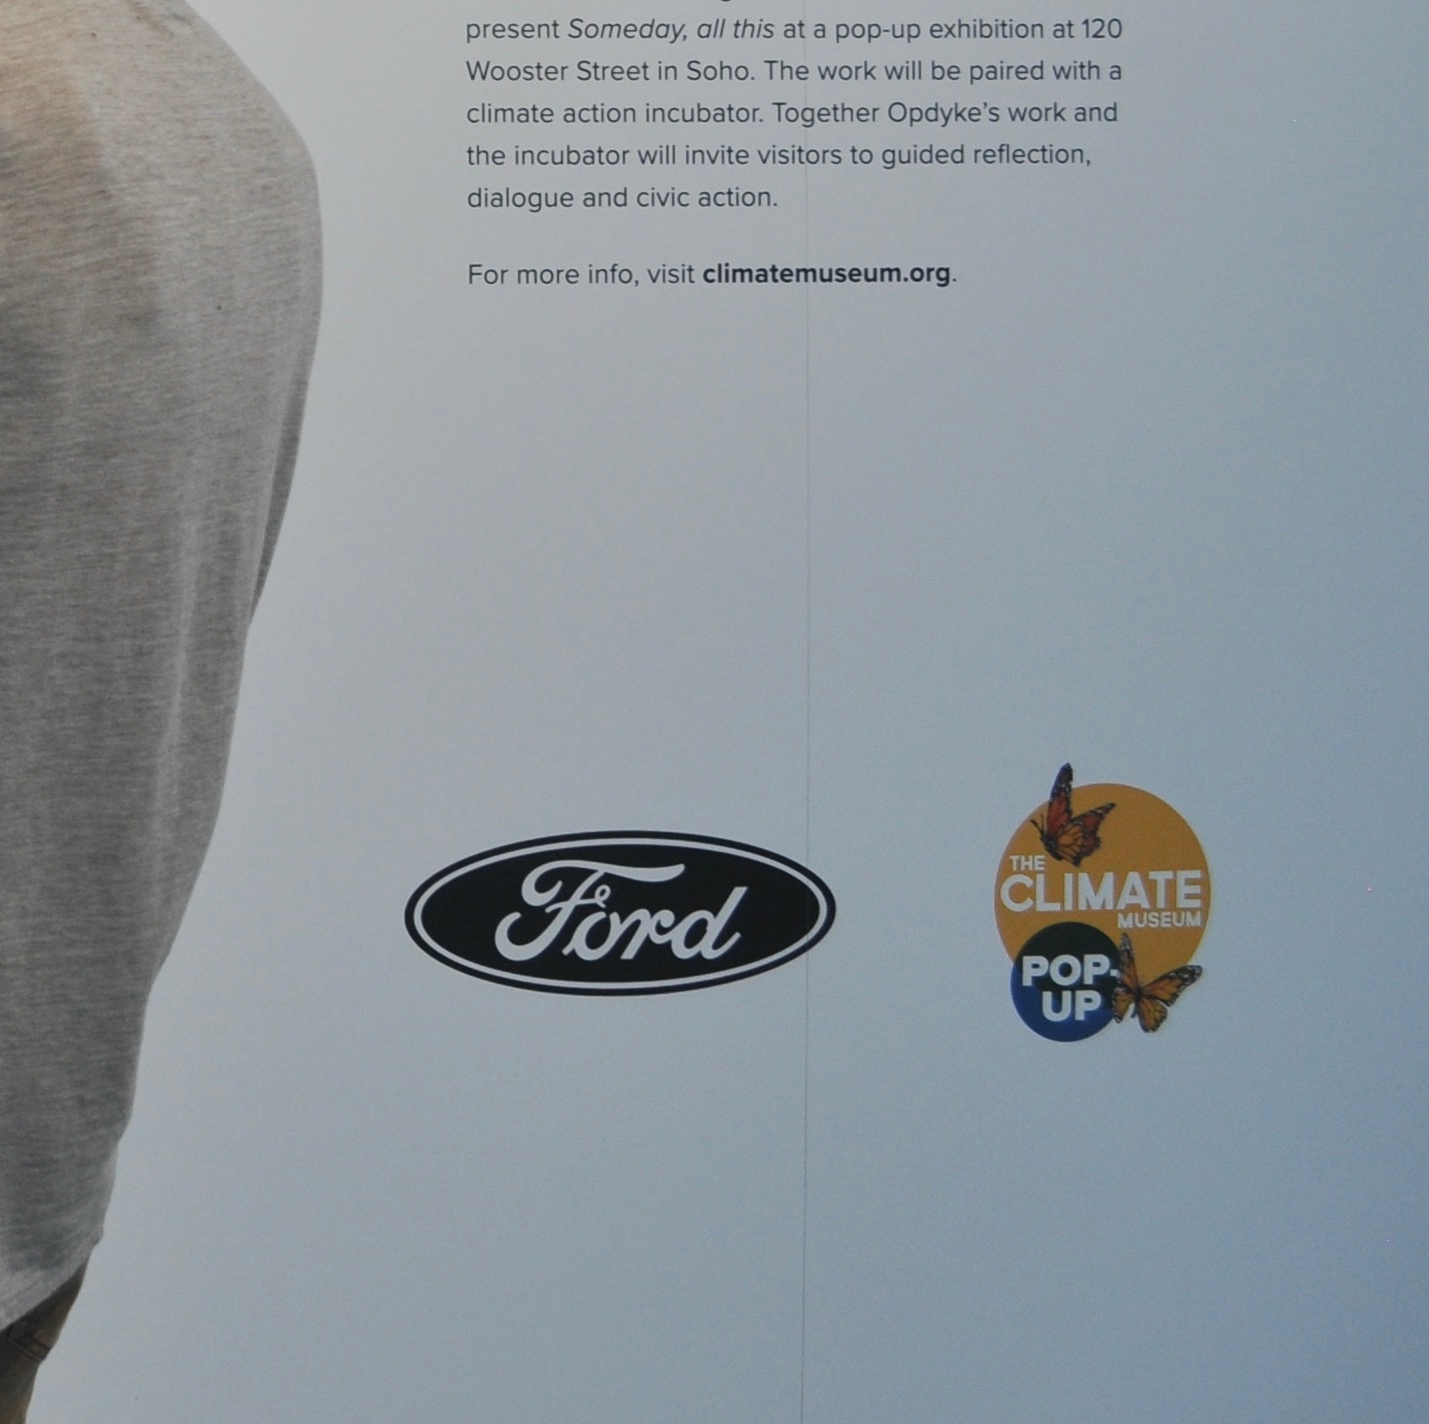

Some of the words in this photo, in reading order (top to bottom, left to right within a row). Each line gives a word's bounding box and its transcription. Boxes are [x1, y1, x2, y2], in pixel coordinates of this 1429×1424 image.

[466, 19, 561, 44] present
[566, 17, 688, 45] Someday,
[696, 17, 727, 39] all
[732, 17, 775, 39] this
[783, 19, 806, 40] at
[813, 22, 827, 40] a
[835, 22, 922, 44] pop-up
[928, 17, 1044, 39] exhibition
[1052, 19, 1076, 39] at
[1081, 17, 1123, 39] 120
[465, 60, 570, 82] Wooster
[576, 59, 651, 82] Street
[657, 60, 678, 81] in
[686, 59, 756, 82] Soho.
[762, 59, 810, 81] The
[816, 59, 878, 81] work
[883, 59, 923, 81] will
[930, 59, 962, 81] be
[969, 59, 1045, 86] paired
[1051, 59, 1101, 81] with
[1108, 64, 1122, 81] a
[466, 102, 555, 124] climate
[562, 102, 637, 124] action
[645, 101, 764, 124] incubator.
[771, 101, 881, 129] Together
[887, 101, 1001, 128] Opdyke’s
[1007, 101, 1067, 123] work
[1073, 101, 1118, 123] and
[465, 144, 506, 166] the
[514, 144, 631, 166] incubator
[637, 144, 676, 166] will
[684, 144, 750, 166] invite
[756, 144, 843, 166] visitors
[849, 145, 874, 165] to
[881, 143, 965, 171] guided
[973, 142, 1092, 167] reflection,
[467, 186, 575, 214] dialogue
[582, 186, 628, 208] and
[636, 186, 690, 208] civic
[697, 186, 778, 208] action.
[468, 263, 510, 285] For
[516, 268, 580, 285] more
[588, 262, 640, 288] info,
[646, 263, 696, 285] visit
[702, 261, 958, 288] climatemuseum.org.
[1009, 855, 1046, 871] THE
[1000, 869, 1202, 912] CLIMATE
[495, 860, 748, 962] Ford
[1117, 911, 1202, 928] MUSEUM
[1042, 989, 1102, 1022] UP
